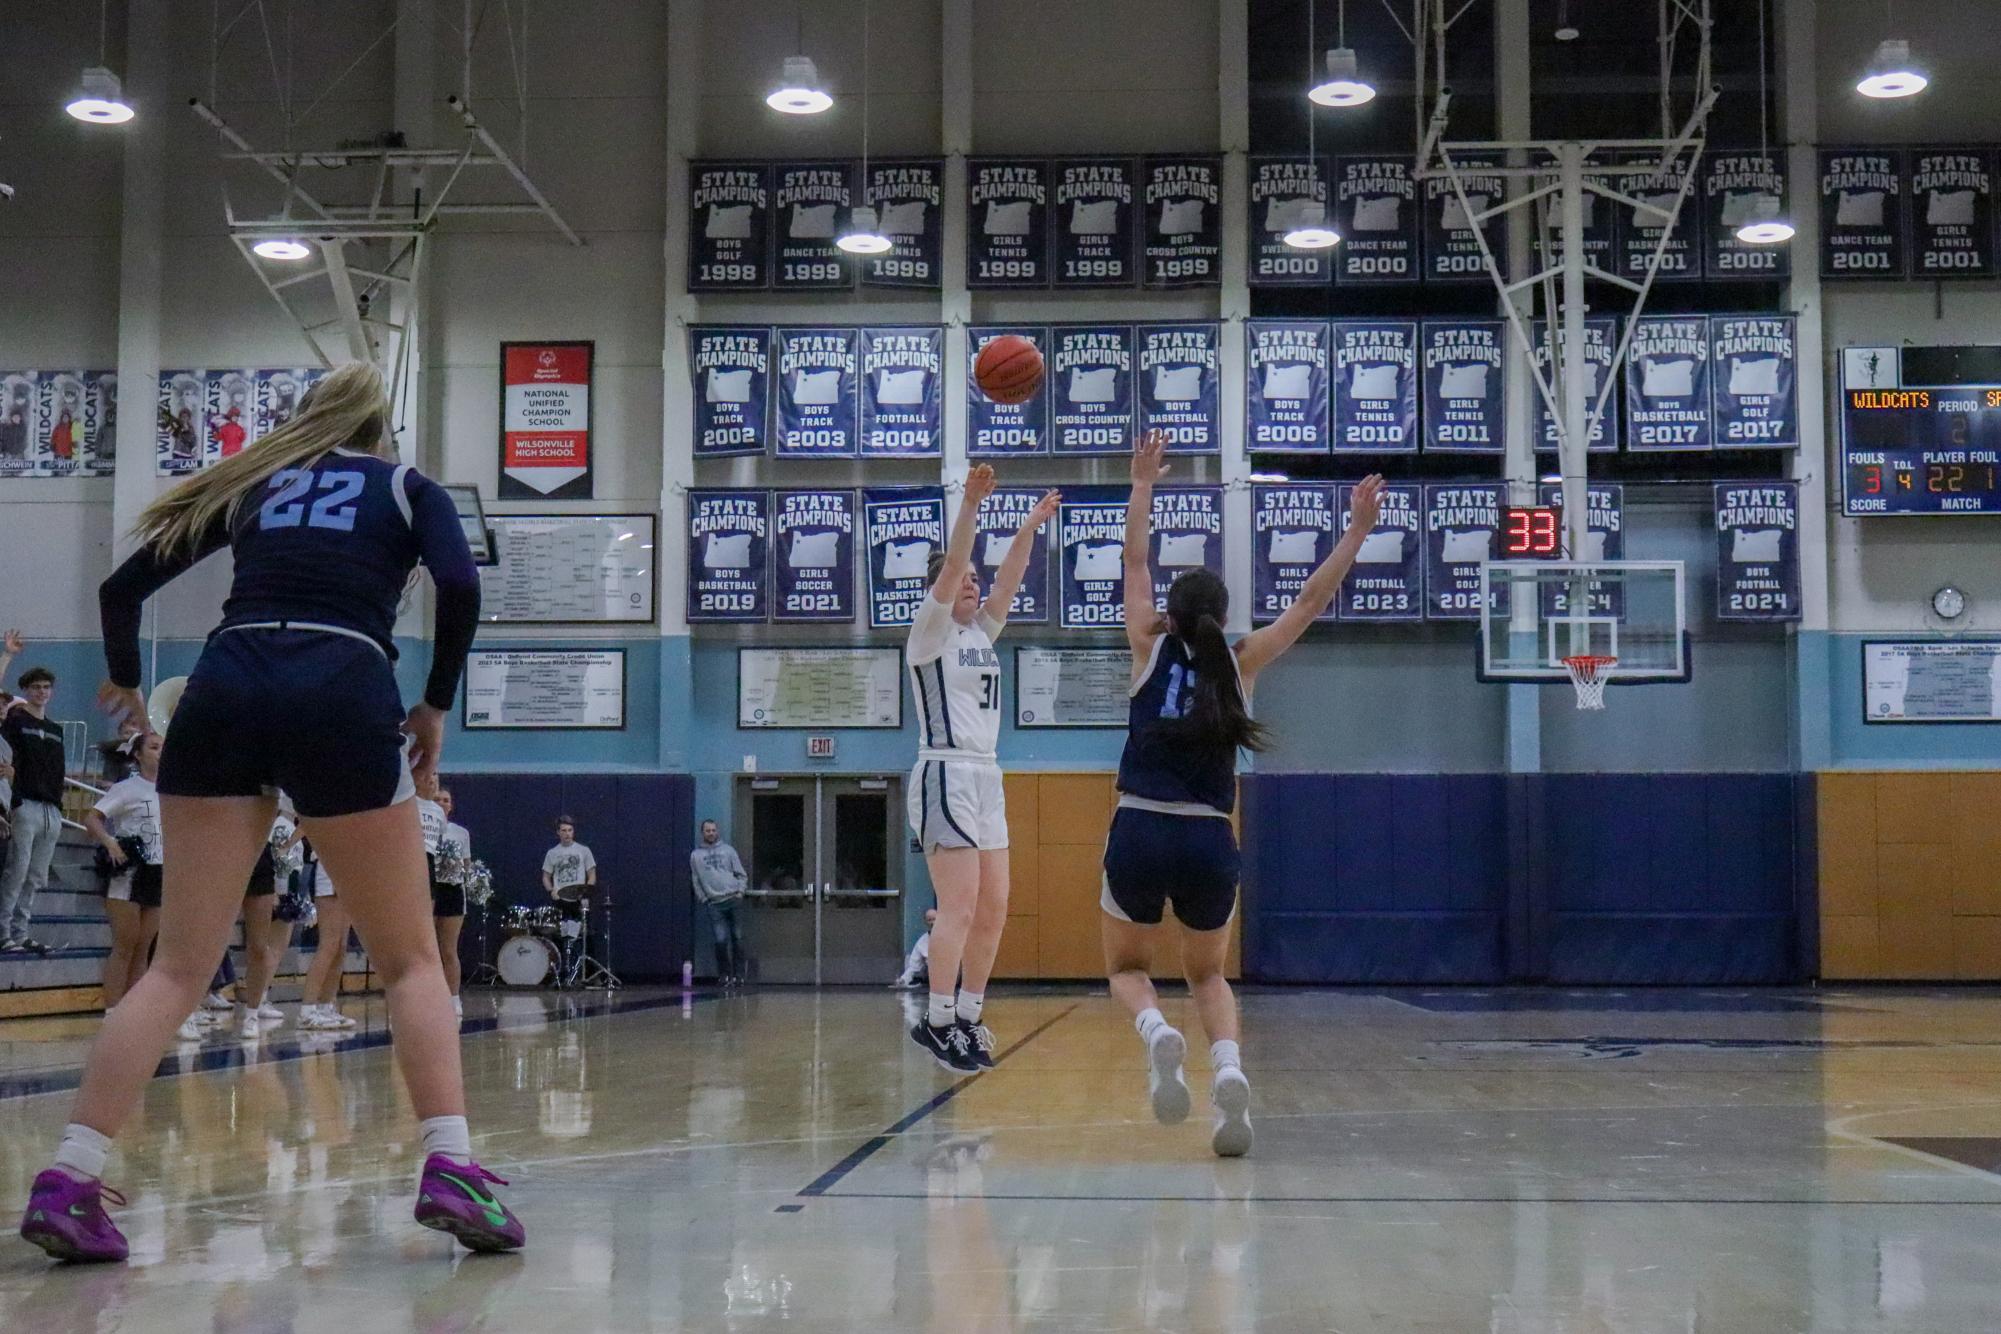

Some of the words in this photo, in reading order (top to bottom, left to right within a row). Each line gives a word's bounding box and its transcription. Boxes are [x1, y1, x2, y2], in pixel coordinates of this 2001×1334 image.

[1260, 165, 1317, 180] STATE
[1347, 164, 1405, 179] STATE
[1715, 158, 1774, 174] STATE
[1830, 157, 1889, 173] STATE
[1921, 156, 1980, 173] STATE
[702, 173, 758, 187] STATE
[785, 171, 841, 187] STATE
[874, 169, 932, 185] STATE
[980, 168, 1037, 184] STATE
[1065, 168, 1122, 183] STATE
[1154, 166, 1210, 182] STATE
[1252, 180, 1326, 202] CHAMPIONS
[1340, 178, 1413, 200] CHAMPIONS
[1707, 174, 1783, 196] CHAMPIONS
[1823, 174, 1898, 195] CHAMPIONS
[1913, 173, 1989, 194] CHAMPIONS
[694, 187, 766, 209] CHAMPIONS
[777, 187, 850, 208] CHAMPIONS
[867, 184, 939, 206] CHAMPIONS
[972, 182, 1045, 204] CHAMPIONS
[1057, 182, 1131, 204] CHAMPIONS
[1147, 181, 1217, 204] CHAMPIONS
[1937, 227, 1967, 235] GIRLS
[717, 240, 741, 248] BOYS
[994, 237, 1022, 245] GIRLS
[1080, 236, 1109, 244] GIRLS
[1171, 235, 1193, 244] BOYS
[1347, 242, 1378, 250] DANCE
[1381, 241, 1407, 250] TEAM
[1831, 237, 1862, 245] DANCE
[1865, 236, 1892, 244] TEAM
[1933, 238, 1972, 247] TENNIS
[717, 252, 741, 260] GOLF
[784, 248, 813, 257] DANCE
[989, 248, 1027, 257] TENNIS
[1077, 248, 1111, 256] TRACK
[1147, 248, 1176, 256] CROSS
[1179, 247, 1217, 255] COUNTRY
[1925, 252, 1981, 267] 2001
[1066, 261, 1122, 276] 1999
[1156, 259, 1209, 277] 1999
[1260, 259, 1318, 273] 2000
[1348, 257, 1407, 273] 2000
[1630, 255, 1687, 270] 2001
[1719, 253, 1776, 268] 2001
[1833, 253, 1890, 268] 2001
[701, 265, 755, 280] 1998
[784, 264, 840, 280] 1999
[873, 260, 928, 278] 1999
[979, 261, 1035, 277] 1999
[1638, 323, 1697, 340] STATE
[1723, 321, 1783, 337] STATE
[702, 336, 758, 352] STATE
[789, 336, 846, 352] STATE
[873, 336, 929, 352] STATE
[1064, 333, 1121, 350] STATE
[1149, 333, 1206, 349] STATE
[1259, 330, 1317, 346] STATE
[1346, 330, 1404, 346] STATE
[1434, 330, 1492, 346] STATE
[1630, 339, 1706, 362] CHAMPIONS
[1716, 337, 1792, 360] CHAMPIONS
[697, 352, 766, 373] CHAMPIONS
[781, 352, 854, 373] CHAMPIONS
[865, 352, 938, 373] CHAMPIONS
[1056, 349, 1130, 372] CHAMPIONS
[1141, 348, 1215, 371] CHAMPIONS
[1251, 346, 1325, 368] CHAMPIONS
[1338, 346, 1412, 368] CHAMPIONS
[1426, 346, 1501, 368] CHAMPIONS
[717, 404, 740, 412] BOYS
[1080, 404, 1105, 412] BOYS
[1166, 402, 1191, 411] BOYS
[1275, 400, 1300, 409] BOYS
[1360, 401, 1389, 409] GIRLS
[1450, 400, 1479, 408] GIRLS
[1740, 397, 1770, 405] GIRLS
[1854, 392, 1929, 408] WILDCATS
[1938, 401, 1978, 412] PERIOD
[805, 406, 829, 415] BOYS
[995, 404, 1020, 413] BOYS
[1271, 412, 1304, 420] TRACK
[1355, 412, 1394, 421] TENNIS
[1445, 412, 1483, 420] TENNIS
[1634, 411, 1706, 422] BASKETBALL
[1743, 408, 1769, 417] GOLF
[39, 381, 51, 455] WILDCATS
[84, 381, 97, 455] WILDCATS
[713, 415, 743, 423] TRACK
[801, 417, 833, 426] TRACK
[876, 415, 926, 423] FOOTBALL
[990, 416, 1023, 424] TRACK
[1056, 416, 1086, 424] CROSS
[1089, 415, 1130, 424] COUNTRY
[1149, 413, 1208, 423] BASKETBALL
[704, 427, 755, 445] 2002
[1257, 426, 1317, 442] 2006
[1347, 426, 1402, 442] 2010
[1439, 425, 1490, 441] 2011
[1641, 426, 1699, 443] 2017
[1728, 420, 1784, 437] 2017
[787, 431, 845, 446] 2003
[871, 430, 929, 447] 2004
[978, 429, 1037, 446] 2004
[1064, 429, 1122, 445] 2005
[180, 460, 198, 469] LAM
[1850, 453, 1885, 464] FOULS
[1894, 461, 1915, 469] T.O.L.
[1923, 452, 1965, 463] PLAYER
[1970, 452, 1998, 462] FOUL
[1866, 467, 1881, 493] 3
[1899, 474, 1911, 489] 4
[1928, 467, 1964, 492] 22
[259, 469, 366, 531] 22
[785, 495, 843, 511] STATE
[1154, 494, 1211, 512] STATE
[1265, 491, 1324, 509] STATE
[1437, 491, 1496, 508] STATE
[1726, 490, 1786, 508] STATE
[1850, 499, 1886, 510] SCORE
[1942, 499, 1981, 509] MATCH
[701, 501, 757, 516] STATE
[877, 506, 931, 523] STATE
[1071, 509, 1126, 523] STATE
[692, 516, 765, 537] CHAMPIONS
[778, 511, 851, 533] CHAMPIONS
[1257, 510, 1331, 531] CHAMPIONS
[1718, 509, 1794, 531] CHAMPIONS
[871, 522, 940, 547] CHAMPIONS
[1509, 512, 1554, 551] 33
[715, 569, 740, 578] BOYS
[800, 569, 828, 578] GIRLS
[1280, 569, 1308, 577] GIRLS
[1746, 568, 1769, 576] BOYS
[699, 580, 757, 590] BASKETBALL
[796, 580, 832, 590] SOCCER
[896, 580, 921, 589] BOYS
[1084, 582, 1114, 591] GIRLS
[1356, 579, 1405, 589] FOOTBALL
[1456, 580, 1480, 589] GOLF
[1736, 580, 1780, 589] FOOTBALL
[701, 595, 755, 610] 2019
[787, 595, 840, 611] 2021
[1086, 592, 1111, 602] GOLF
[1353, 595, 1408, 610] 2023
[1730, 594, 1787, 609] 2024
[979, 674, 999, 710] 31
[812, 738, 831, 753] EXIT
